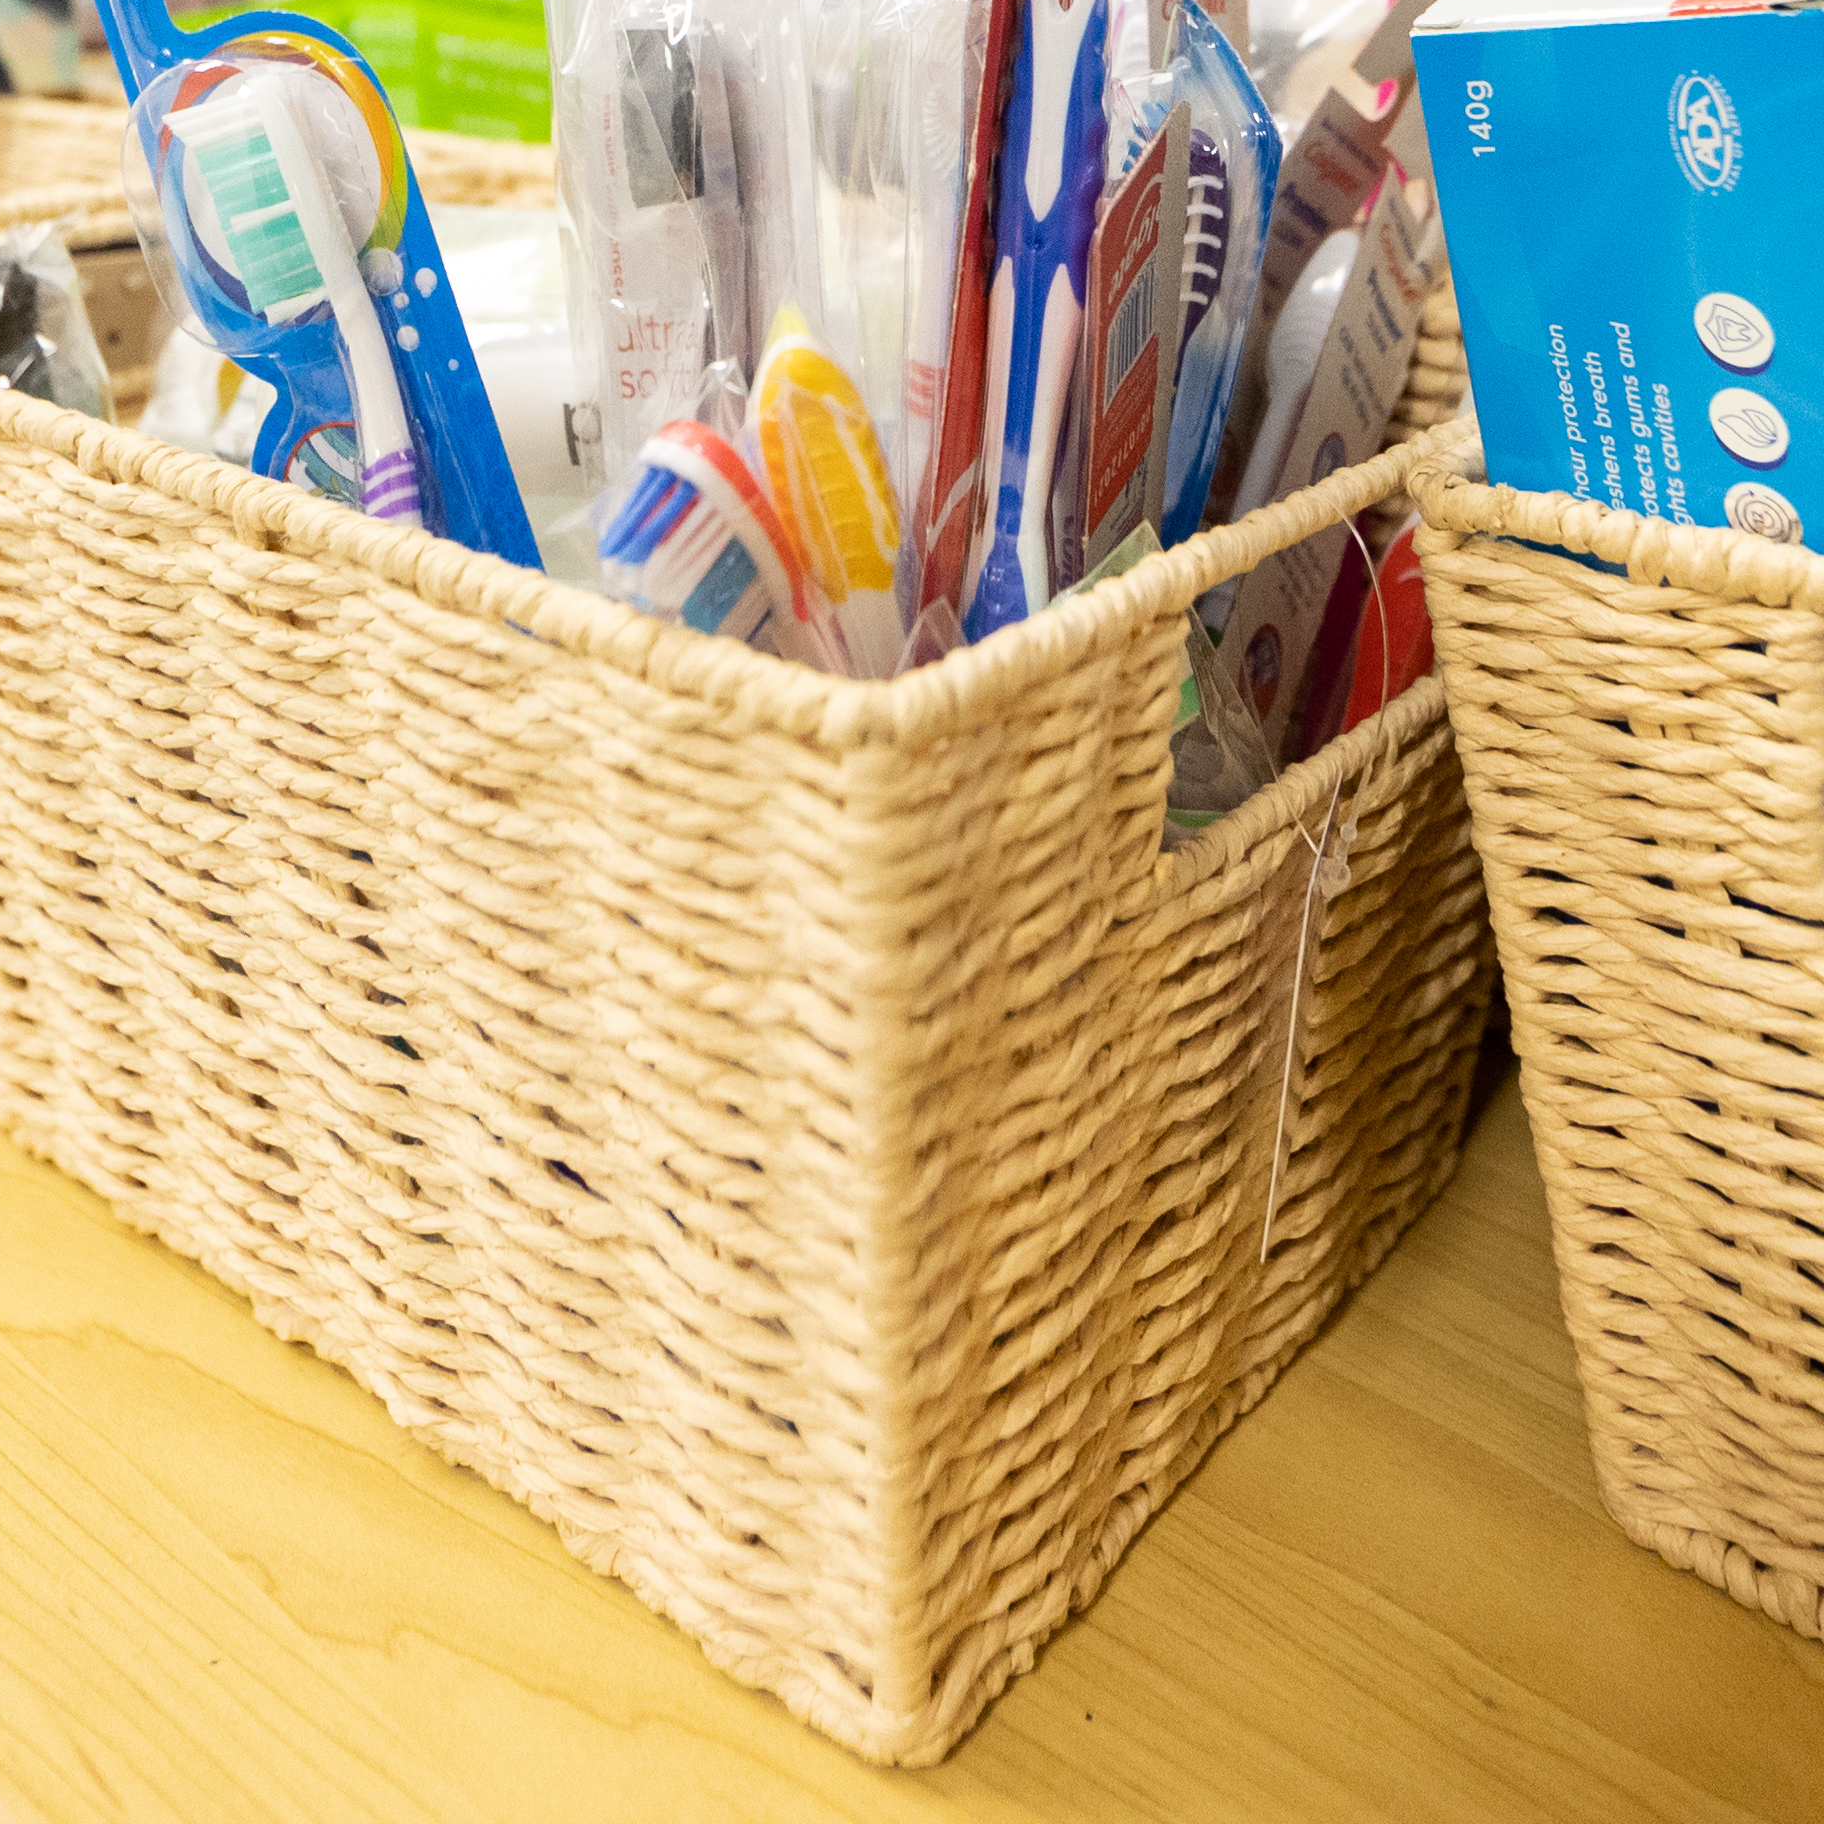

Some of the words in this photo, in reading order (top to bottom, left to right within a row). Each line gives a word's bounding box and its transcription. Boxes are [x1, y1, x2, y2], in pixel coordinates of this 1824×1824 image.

[1466, 80, 1495, 157] 140g
[1686, 94, 1724, 171] ADA
[1609, 320, 1636, 369] and
[1548, 323, 1587, 444] protection
[1582, 350, 1613, 429] breath
[1622, 374, 1653, 439] gums
[1650, 382, 1682, 473] cavities
[1569, 446, 1592, 502] hour
[1598, 433, 1627, 511] eshens
[1632, 443, 1660, 517] otects
[1667, 476, 1697, 527] ghts
